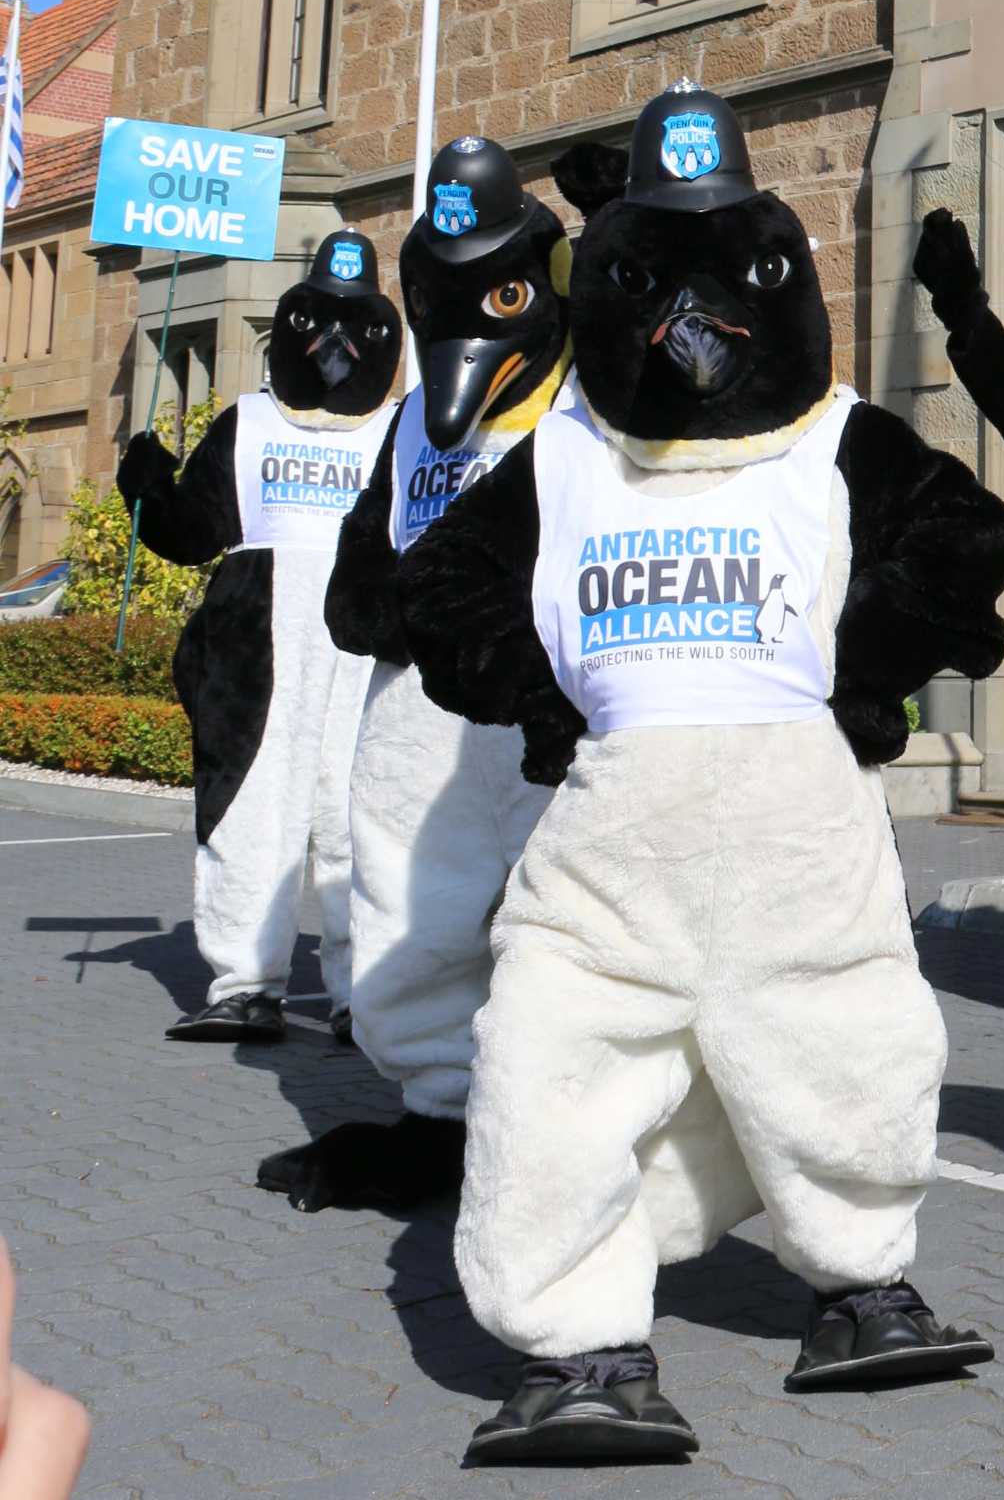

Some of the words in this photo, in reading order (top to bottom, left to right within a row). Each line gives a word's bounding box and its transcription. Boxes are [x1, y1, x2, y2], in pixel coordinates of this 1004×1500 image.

[139, 135, 245, 176] SAVE
[670, 131, 710, 145] POLICE
[148, 172, 230, 206] OUR
[123, 201, 246, 244] HOME
[261, 457, 362, 491] OCEAN
[262, 442, 362, 466] ANTARCTIC
[408, 461, 487, 502] OCEA
[578, 526, 760, 566] ANTARCTIC
[578, 558, 760, 616] OCEAN
[585, 609, 753, 649] ALLIANCE
[580, 648, 653, 673] PROTECTING
[659, 647, 683, 660] THE
[689, 646, 724, 659] WILD
[730, 647, 775, 661] SOUTH
